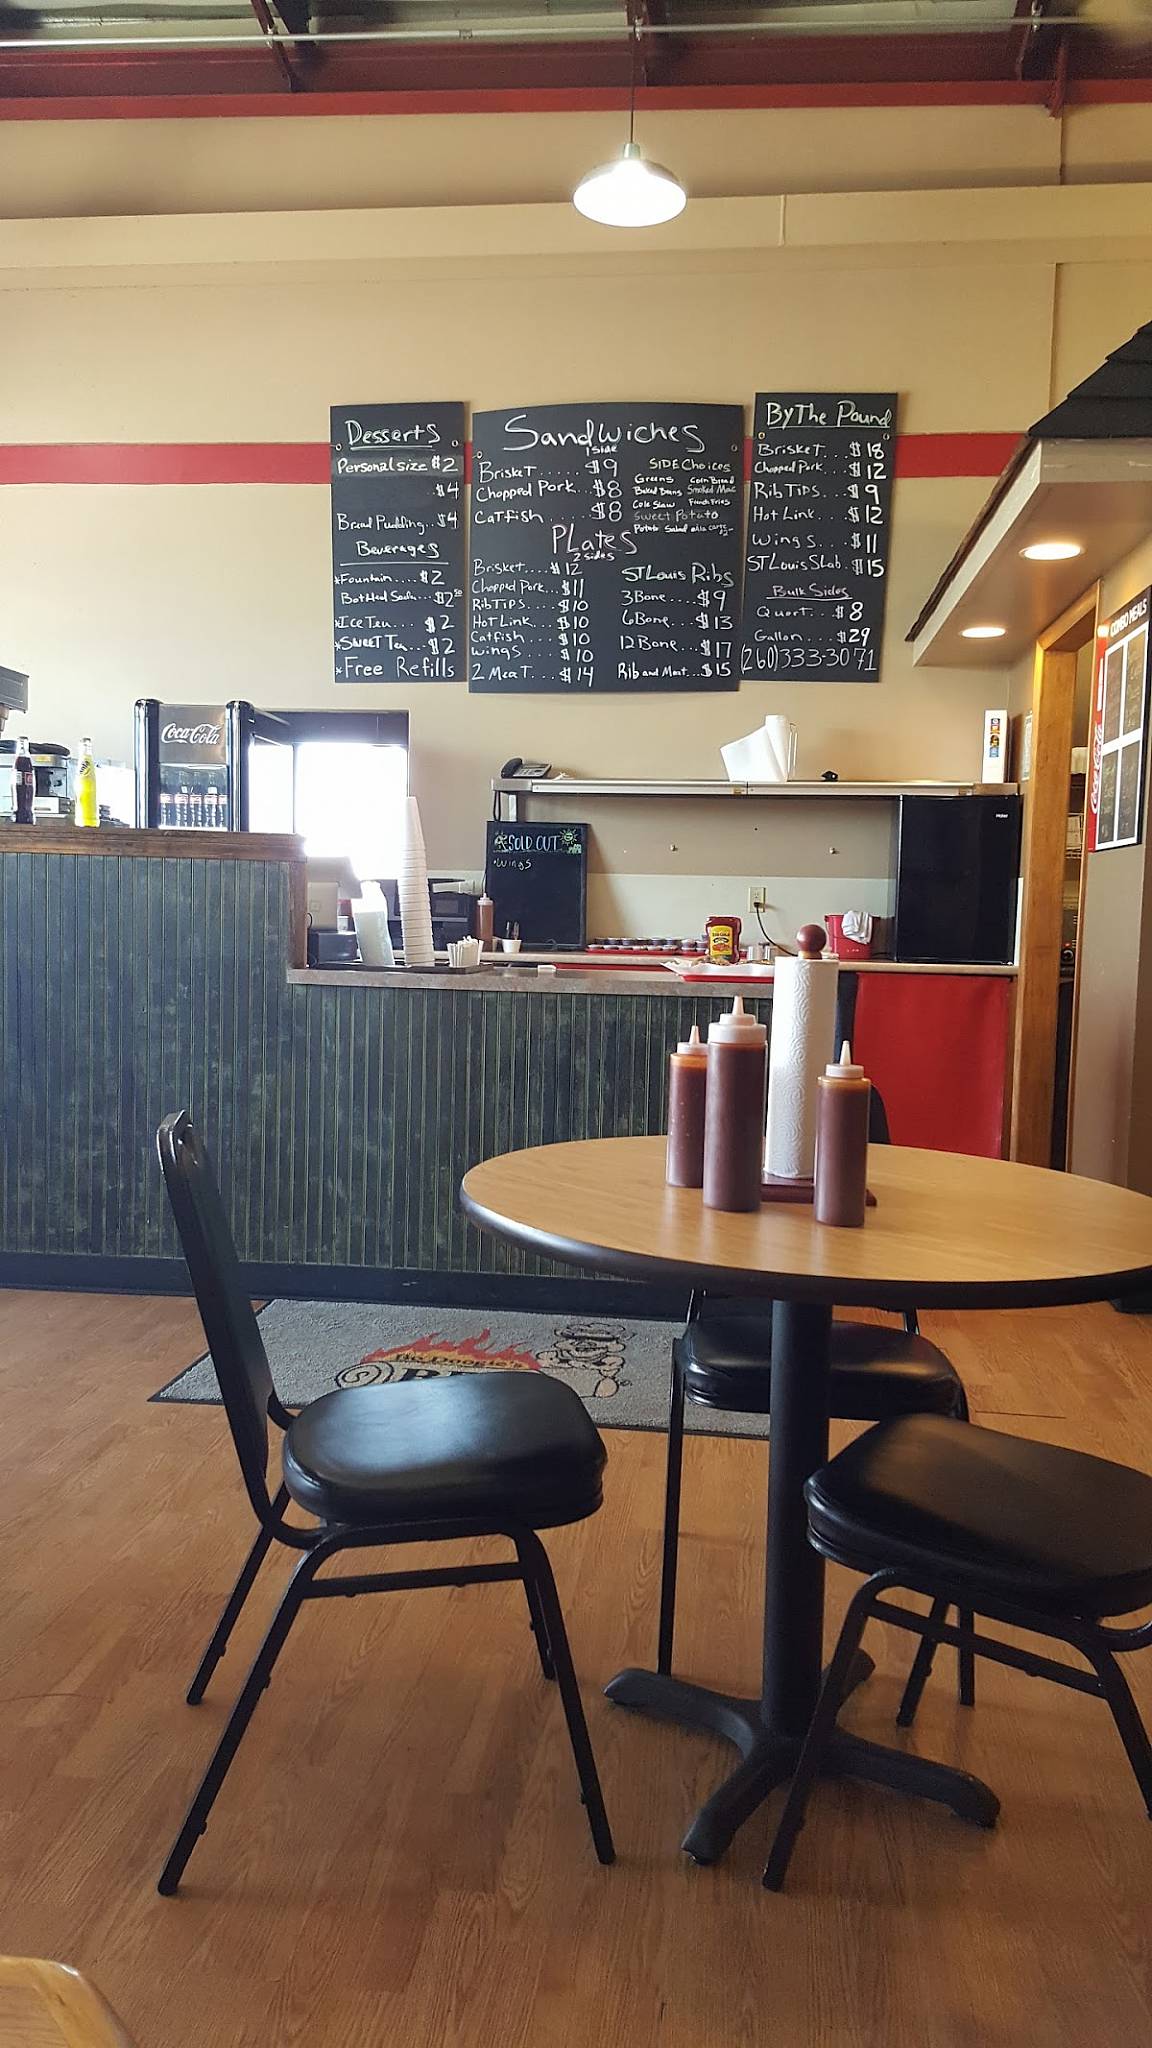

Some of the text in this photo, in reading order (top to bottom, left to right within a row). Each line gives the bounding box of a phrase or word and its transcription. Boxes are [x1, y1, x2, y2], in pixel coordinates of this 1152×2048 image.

[837, 400, 892, 428] Pound
[345, 420, 440, 445] Desserts
[849, 441, 884, 460] $18
[337, 455, 458, 474] Personal size $2
[585, 459, 617, 477] $9
[649, 458, 731, 473] SIDE Choices
[754, 459, 887, 480] Chopped Pork $12
[634, 473, 674, 484] Greens
[436, 481, 459, 499] $4
[476, 479, 622, 502] Chopped Pork $8
[632, 486, 683, 496] Baked Beans
[687, 484, 737, 494] Smoked Mac
[847, 483, 879, 505] $9
[591, 501, 622, 522] $8
[632, 499, 651, 509] Cole
[337, 511, 457, 535] Bread Pudding $4
[634, 509, 719, 522] Sweet Potato
[753, 504, 883, 524] Hot Link $12
[633, 523, 659, 534] Potato
[664, 523, 688, 533] Salad
[356, 541, 439, 558] Beverages
[752, 532, 877, 554] Wings $11
[583, 550, 615, 561] sides
[550, 562, 583, 576] $12
[691, 562, 734, 588] Ribs
[852, 558, 885, 577] $15
[340, 570, 445, 585] Fountain $2
[471, 578, 584, 598] Chopped Pork $11
[772, 583, 849, 598] Bulk Sides
[558, 599, 589, 613] $10
[697, 589, 726, 611] $9
[835, 601, 863, 621] $8
[339, 615, 454, 633] Ice Tea $2
[500, 614, 534, 628] Link
[557, 616, 589, 631] $10
[695, 612, 733, 630] $13
[384, 634, 408, 651] Tea
[428, 637, 455, 655] $2
[471, 631, 590, 646] Catfish $10
[754, 627, 870, 647] Gallon $29
[560, 648, 593, 663] $10
[700, 639, 732, 658] $17
[344, 656, 454, 678] Free Refills
[471, 663, 484, 680] 2
[559, 666, 593, 687] $14
[617, 661, 731, 680] Rib and Meat $15
[162, 723, 222, 744] Coca-Cola
[536, 835, 560, 851] OUT
